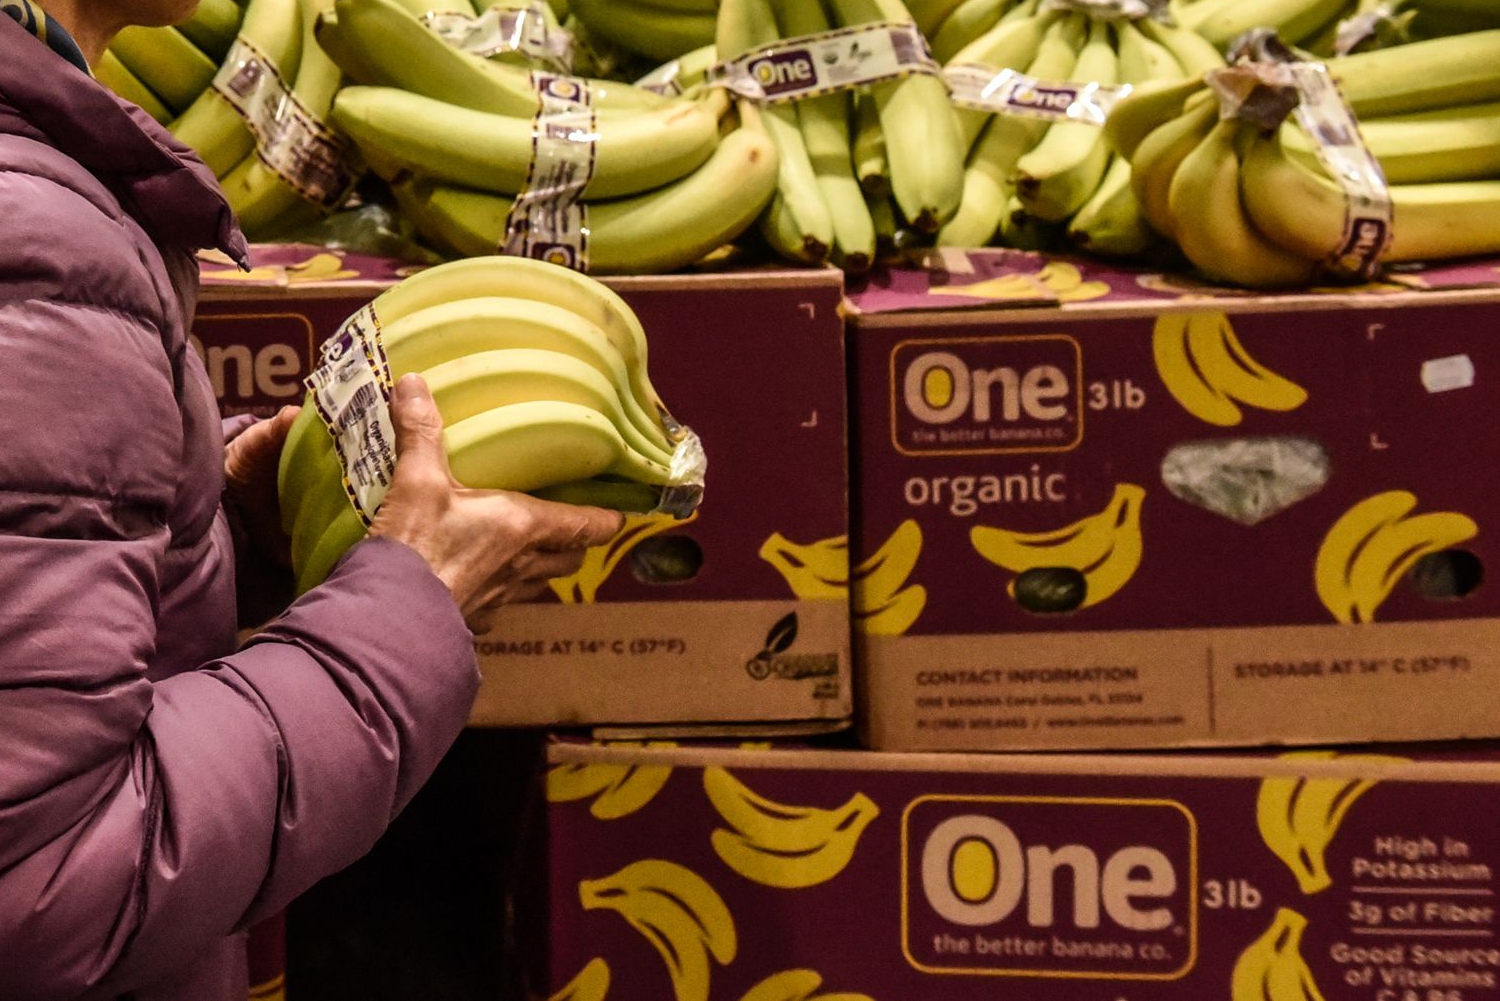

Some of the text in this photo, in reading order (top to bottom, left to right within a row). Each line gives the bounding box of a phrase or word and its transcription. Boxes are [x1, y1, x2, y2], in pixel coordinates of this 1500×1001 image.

[752, 56, 812, 87] One
[190, 335, 301, 399] ne
[904, 351, 1069, 424] One
[904, 463, 1066, 517] organic
[474, 640, 544, 656] TORAGE
[550, 640, 573, 655] AT
[611, 640, 624, 655] C
[916, 667, 1138, 686] CONTACT INFORMATION
[1234, 660, 1323, 678] STORAGE
[1330, 659, 1352, 675] AT
[1392, 658, 1406, 674] C
[1374, 837, 1470, 860] High in
[921, 814, 1177, 931] One
[1351, 857, 1492, 880] Potassium
[1348, 900, 1494, 924] 3g of Fiber
[934, 934, 1172, 960] the better banana co.
[1329, 942, 1500, 966] Good Source
[1345, 965, 1496, 988] of Vitamins
